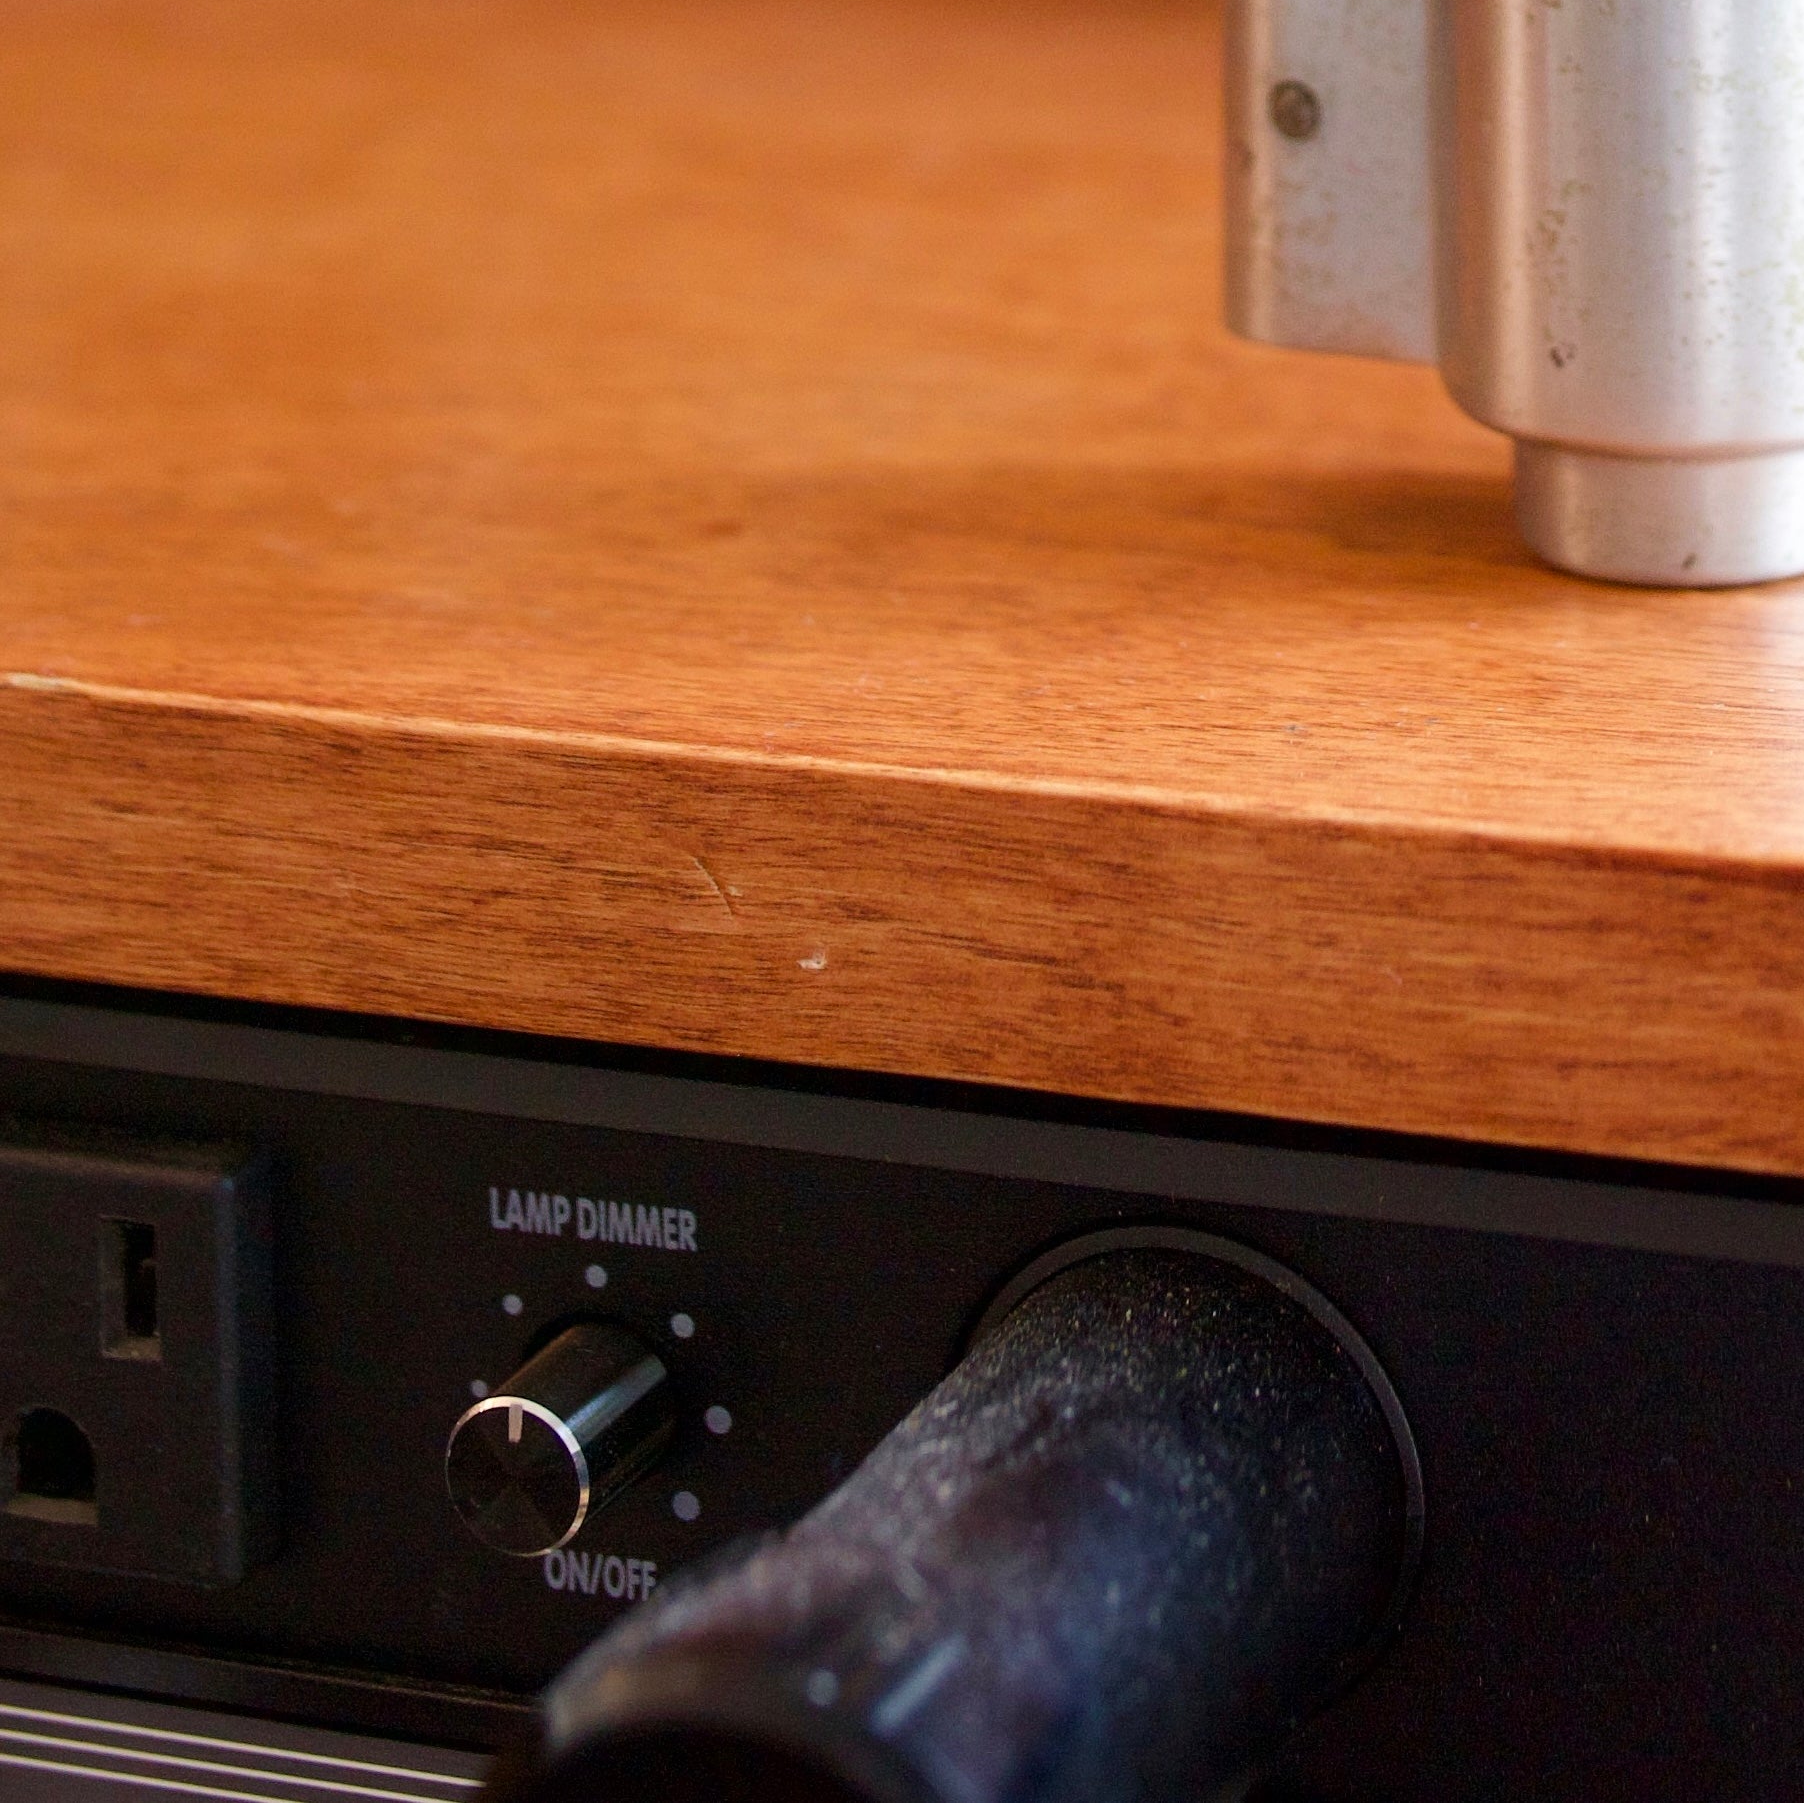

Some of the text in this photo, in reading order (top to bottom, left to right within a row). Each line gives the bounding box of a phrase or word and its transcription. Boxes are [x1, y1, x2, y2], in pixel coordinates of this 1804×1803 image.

[488, 1186, 699, 1252] LAMP DIMMER
[542, 1549, 659, 1602] ON/OFF
